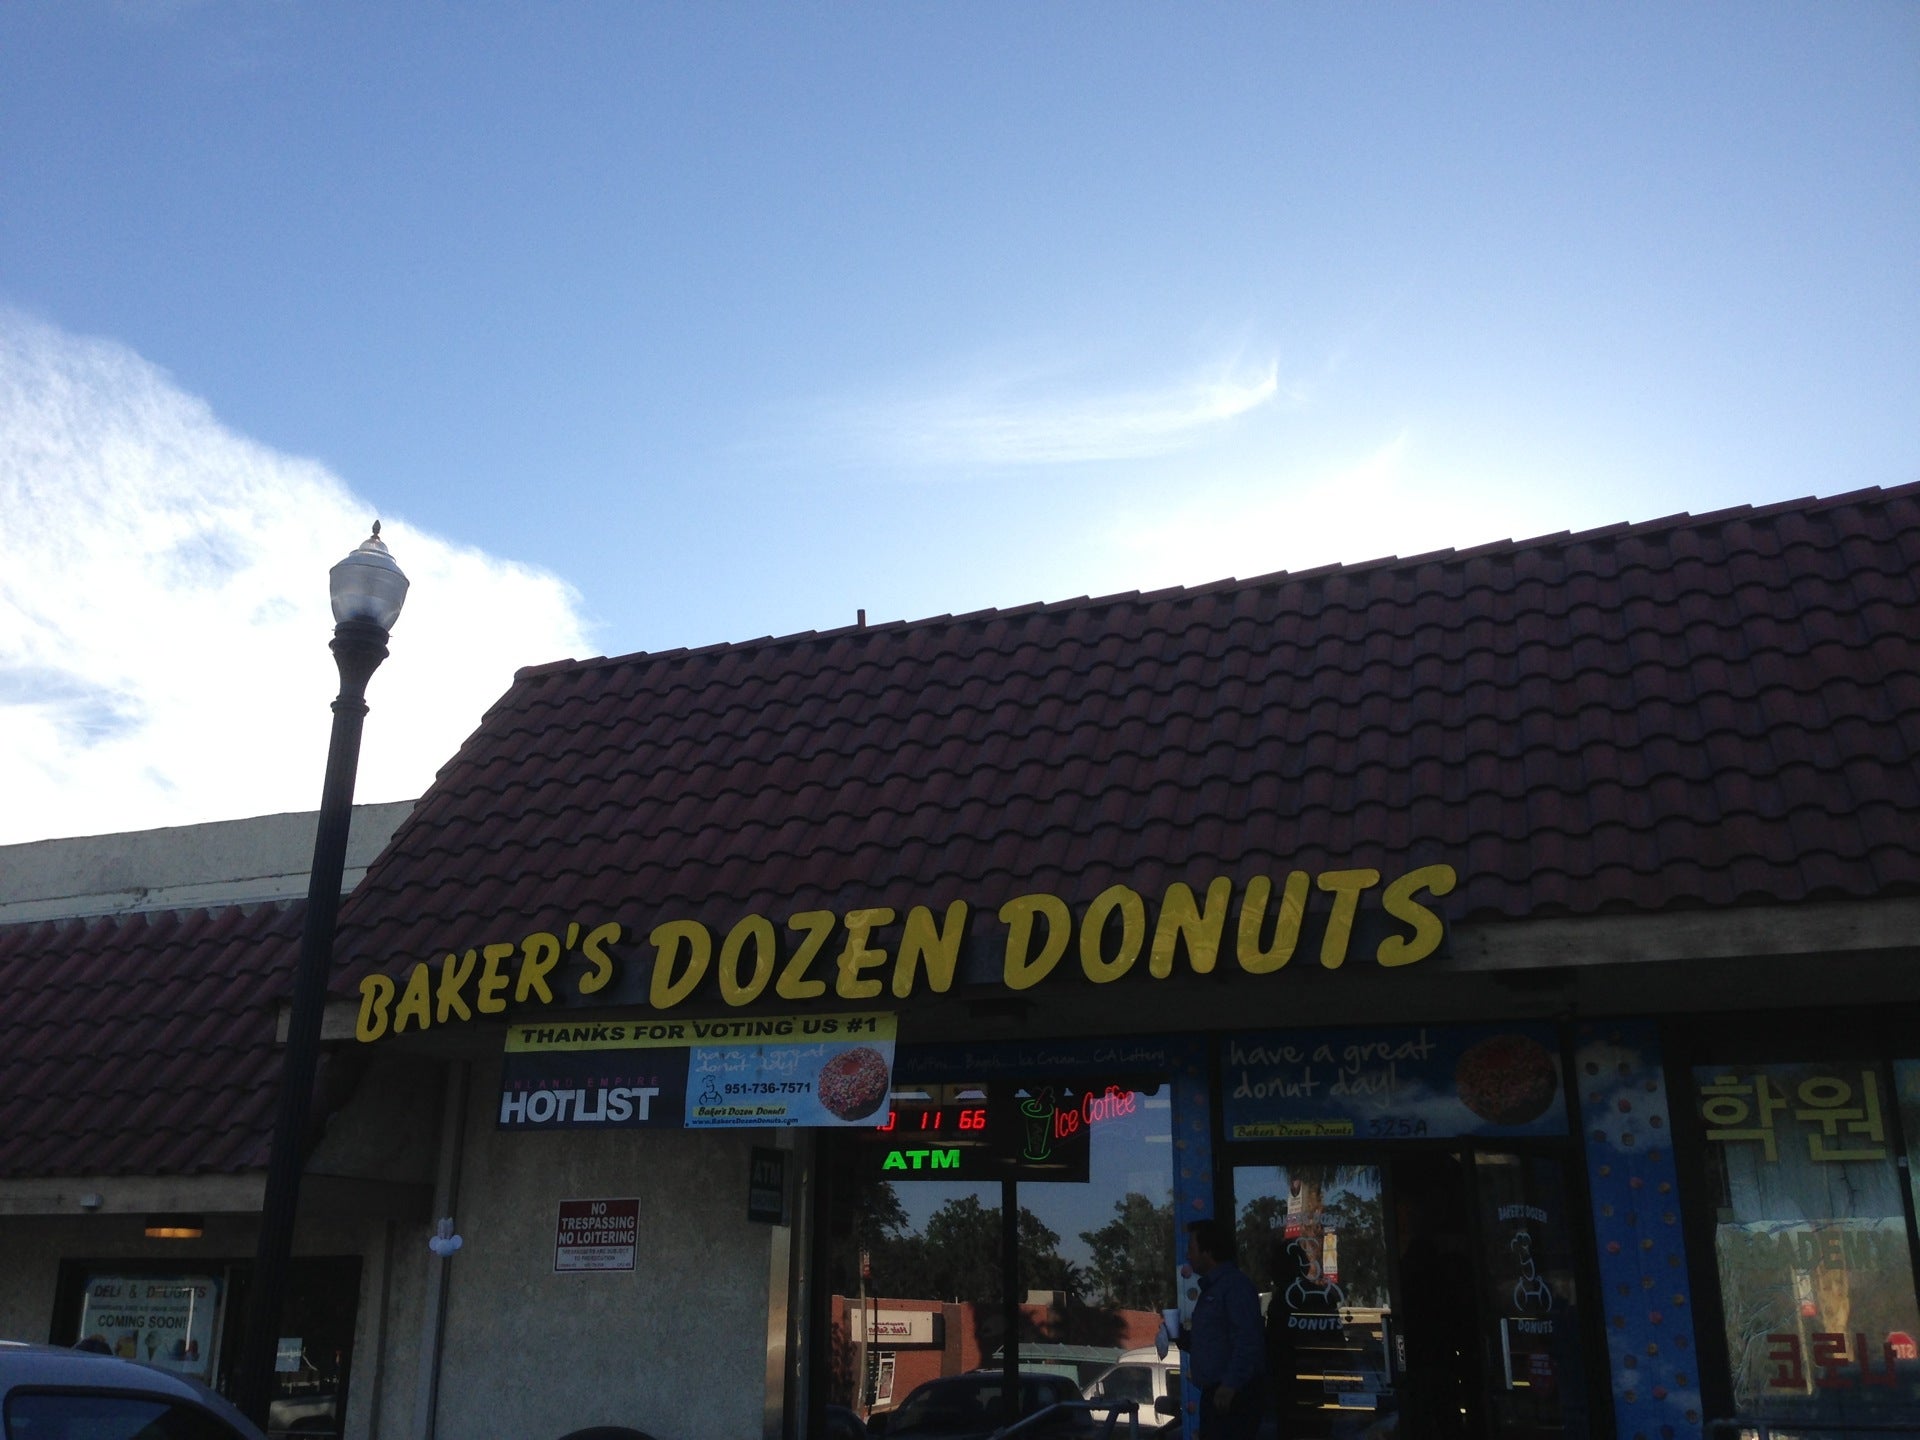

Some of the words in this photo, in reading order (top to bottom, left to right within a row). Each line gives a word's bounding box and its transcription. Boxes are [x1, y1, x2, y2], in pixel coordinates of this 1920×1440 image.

[354, 921, 622, 1044] BAKER'S
[648, 899, 968, 1010] DOZEN
[998, 863, 1457, 991] DONUTS
[522, 1026, 625, 1043] THANKS
[633, 1025, 685, 1041] FOR
[694, 1020, 794, 1038] VOTING
[803, 1019, 838, 1034] US
[847, 1016, 876, 1033] #1
[1231, 1039, 1304, 1067] have
[1312, 1043, 1335, 1064] a
[1343, 1028, 1436, 1075] great
[505, 1078, 573, 1090] INLAND
[586, 1075, 659, 1088] EMPIRE
[724, 1082, 811, 1095] 951-736-7571
[1233, 1065, 1320, 1100] donut
[500, 1087, 660, 1124] HOTLIST
[698, 1106, 727, 1117] Baker's
[728, 1106, 753, 1116] Dozen
[756, 1106, 786, 1116] Donuts
[1053, 1106, 1079, 1139] Ice
[1081, 1083, 1137, 1125] Coffee
[957, 1109, 987, 1131] 66
[1701, 1071, 1887, 1162] 학원
[881, 1149, 961, 1171] ATM
[591, 1202, 608, 1215] NO
[562, 1215, 636, 1230] TRESPASSING
[559, 1231, 574, 1245] NO
[577, 1230, 636, 1244] LOITERING
[94, 1285, 121, 1297] DELI
[128, 1284, 137, 1298] &
[98, 1314, 145, 1328] COMING
[148, 1316, 187, 1329] SOON!
[1287, 1315, 1344, 1330] DONUTS
[1517, 1319, 1553, 1333] DONUTS
